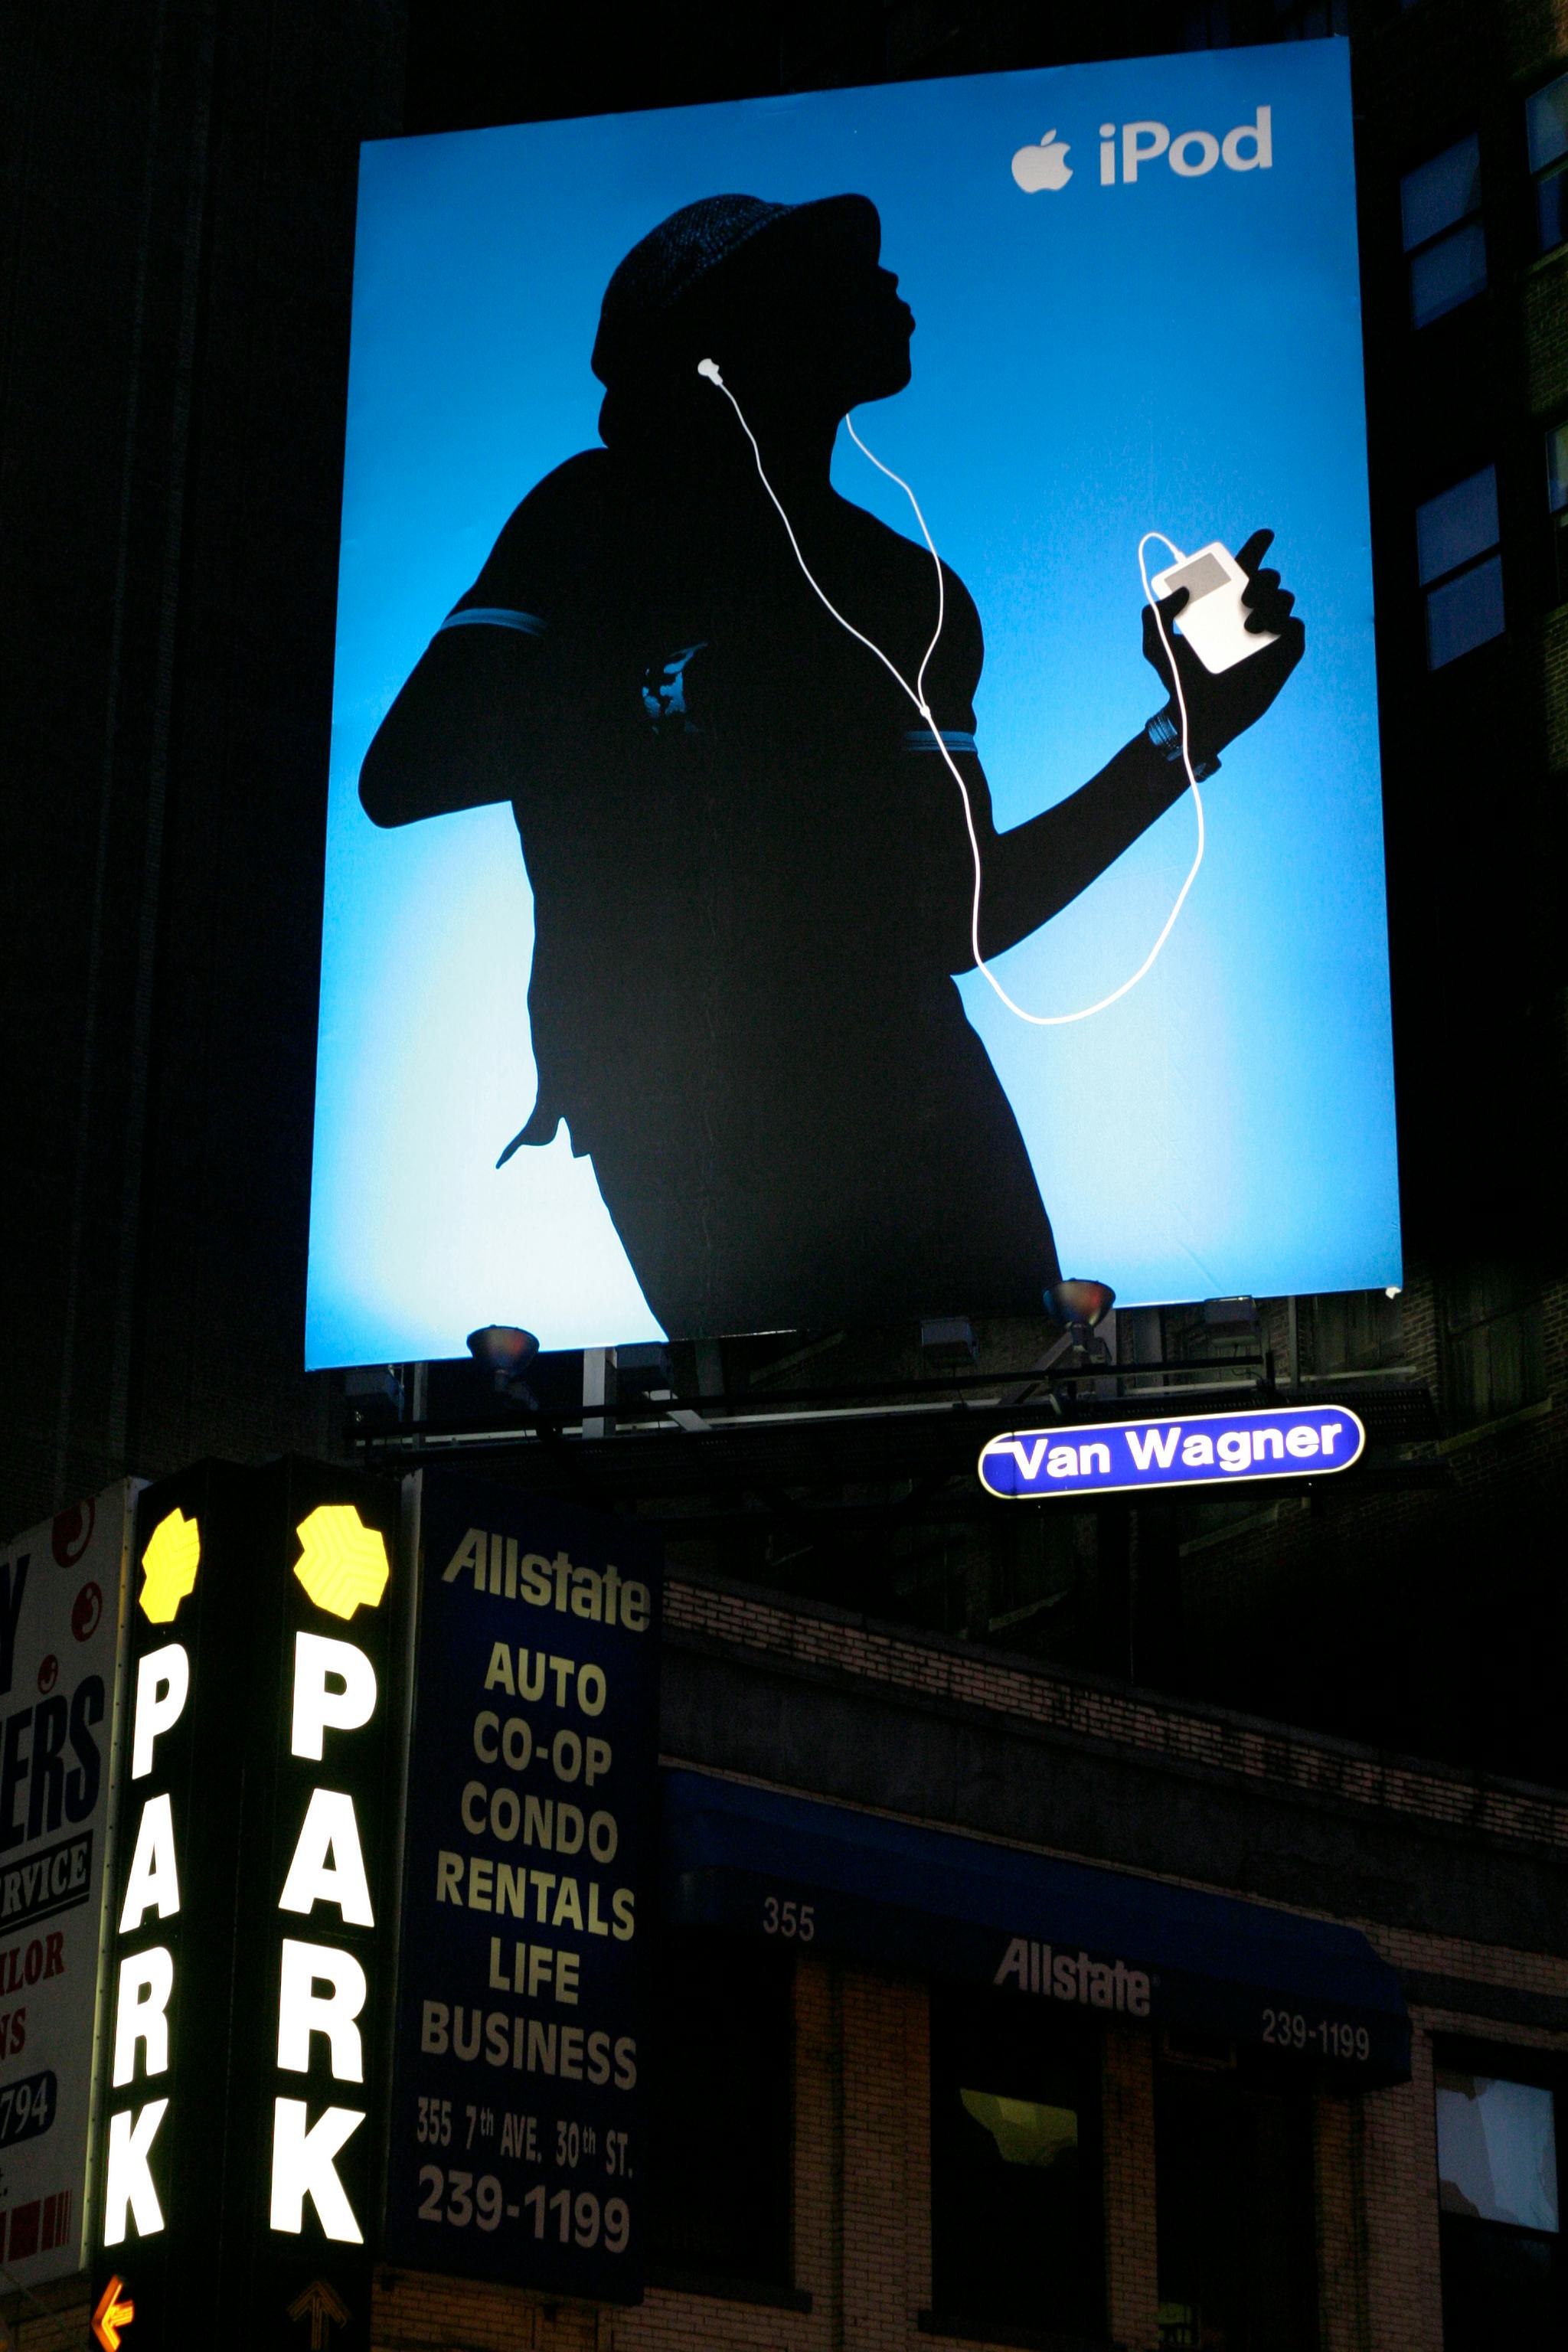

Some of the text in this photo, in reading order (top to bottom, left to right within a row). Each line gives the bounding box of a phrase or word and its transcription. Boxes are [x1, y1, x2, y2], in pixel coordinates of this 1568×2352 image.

[1099, 105, 1272, 186] iPod
[1014, 1423, 1342, 1480] Van Wagner
[441, 1527, 651, 1632] Allstate
[483, 1641, 607, 1717] AUTO
[0, 1675, 105, 1853] ERS
[472, 1710, 612, 1787] CO-OP
[461, 1779, 619, 1864] CONDO
[0, 1840, 88, 1915] RVICE
[435, 1850, 636, 1942] RENTALS
[104, 1642, 190, 2246] PARK
[270, 1631, 377, 2244] PARK
[763, 1896, 815, 1942] 355
[488, 1936, 580, 2006] LIFE
[993, 1937, 1151, 2017] Allstate
[420, 1999, 637, 2091] BUSINESS
[1262, 2008, 1370, 2062] 239-1199
[416, 2096, 633, 2179] 355 7th AVE. 30th ST.
[417, 2164, 630, 2254] 239-1199
